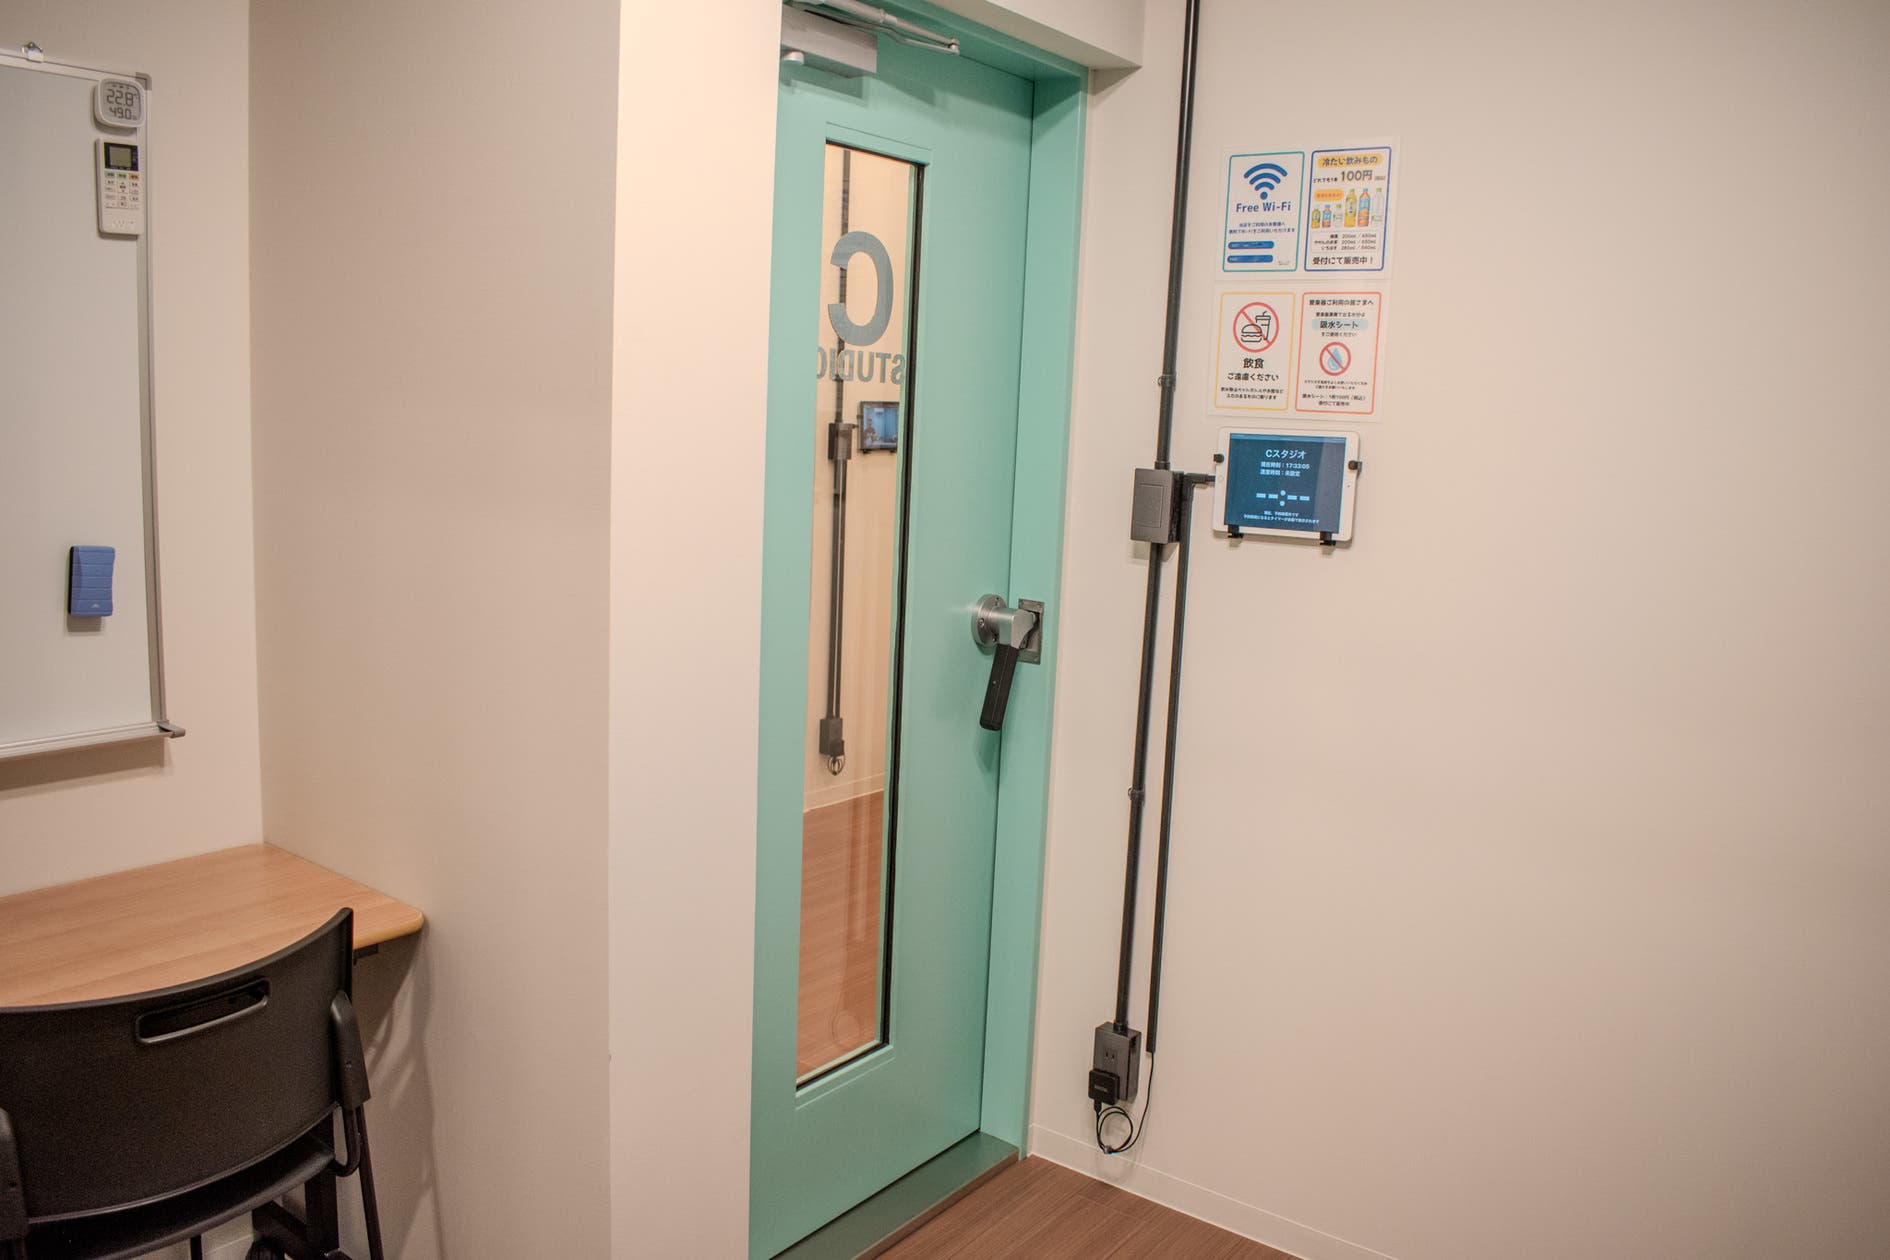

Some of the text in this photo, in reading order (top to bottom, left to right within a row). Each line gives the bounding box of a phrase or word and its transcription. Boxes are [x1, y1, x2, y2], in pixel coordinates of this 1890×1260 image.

[1322, 156, 1378, 167] 冷たい飲みもの
[1340, 170, 1373, 181] 100円
[1236, 201, 1291, 212] Free Wi-Fi
[1320, 320, 1359, 329] 吸水シート
[1243, 358, 1264, 369] 飲食
[1227, 372, 1279, 381] ご遠慮ください
[1265, 449, 1307, 460] Cスタジオ
